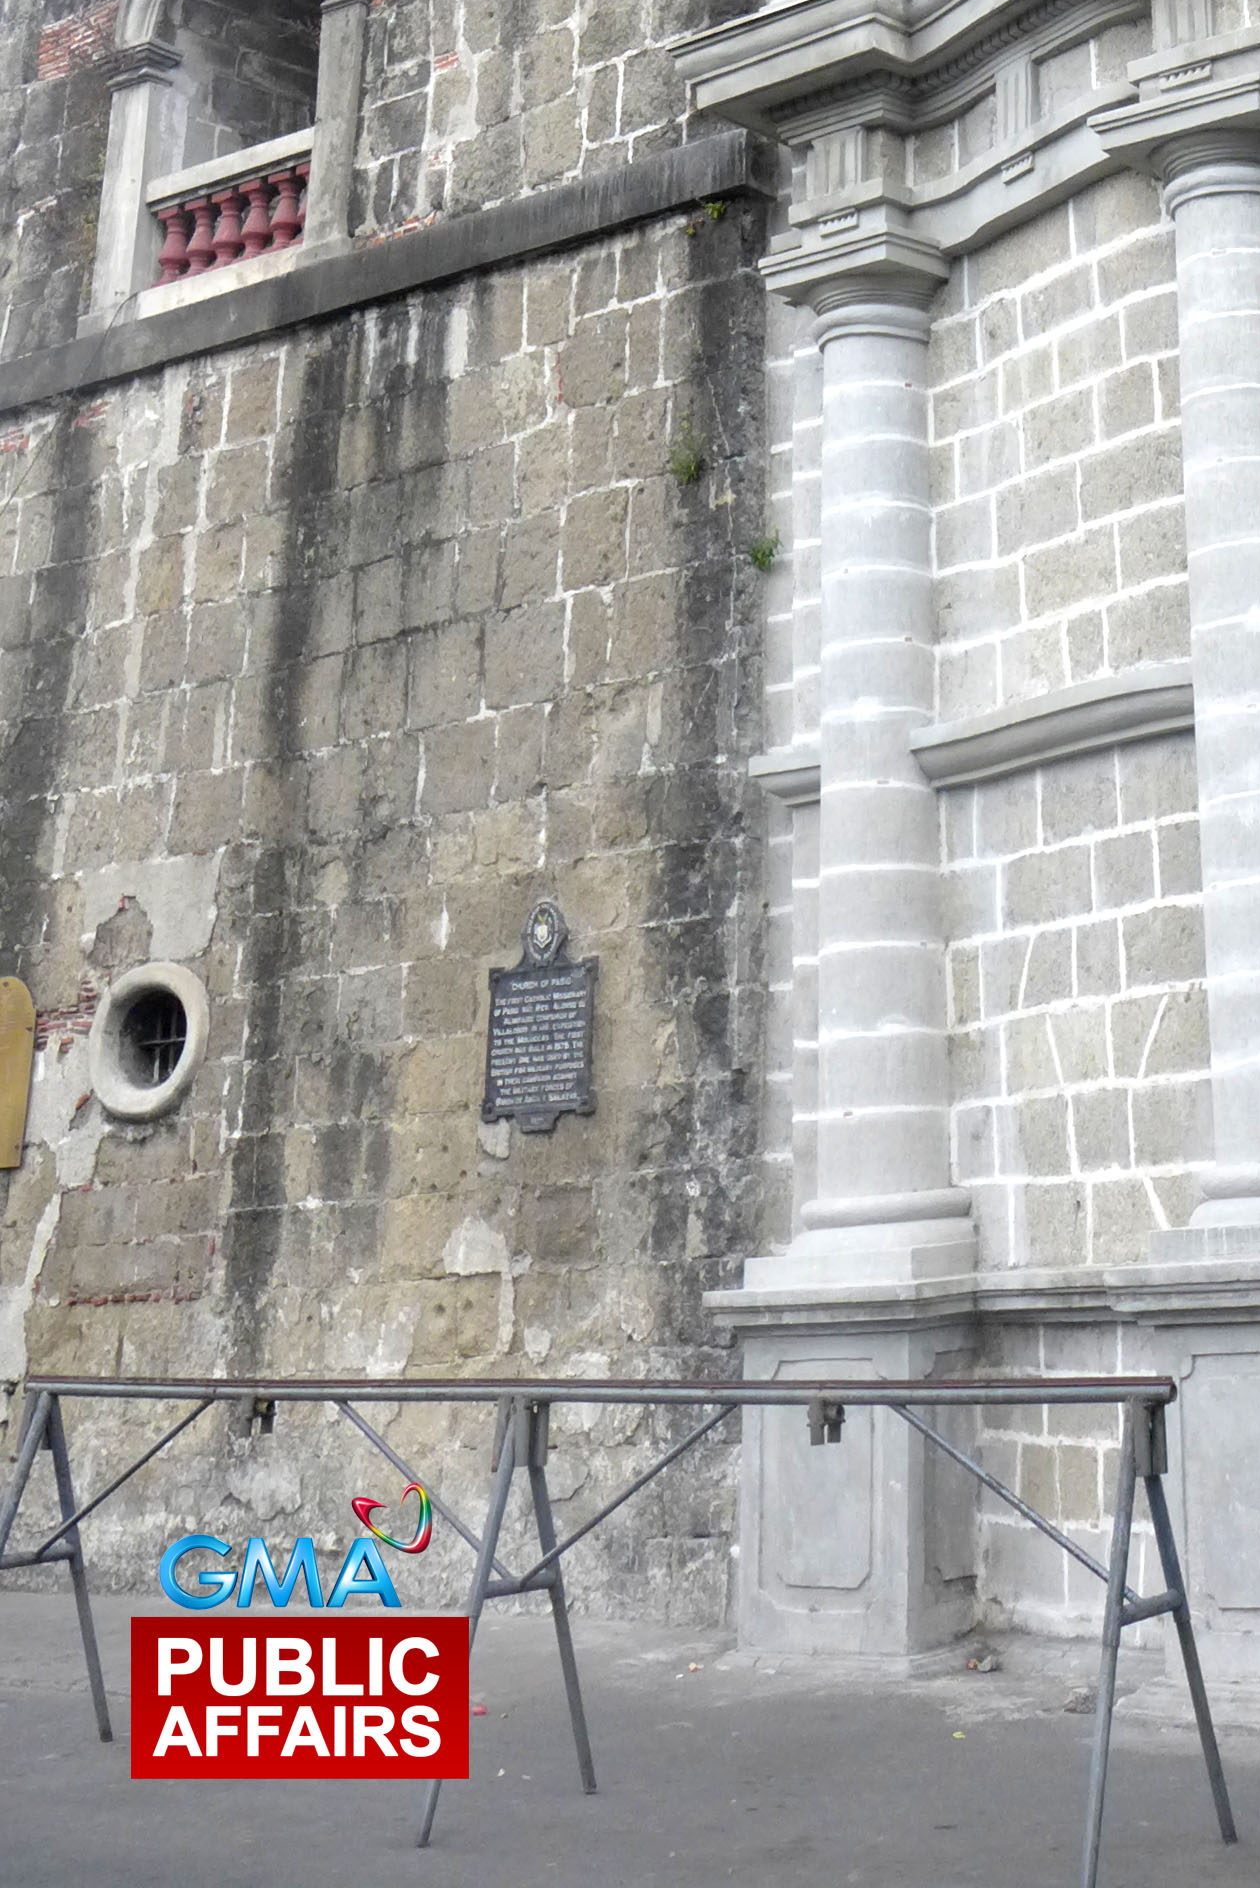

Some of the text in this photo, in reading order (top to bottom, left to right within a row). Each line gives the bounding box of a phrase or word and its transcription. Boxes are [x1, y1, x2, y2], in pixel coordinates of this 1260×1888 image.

[512, 976, 571, 991] CHURCH OF PASIG
